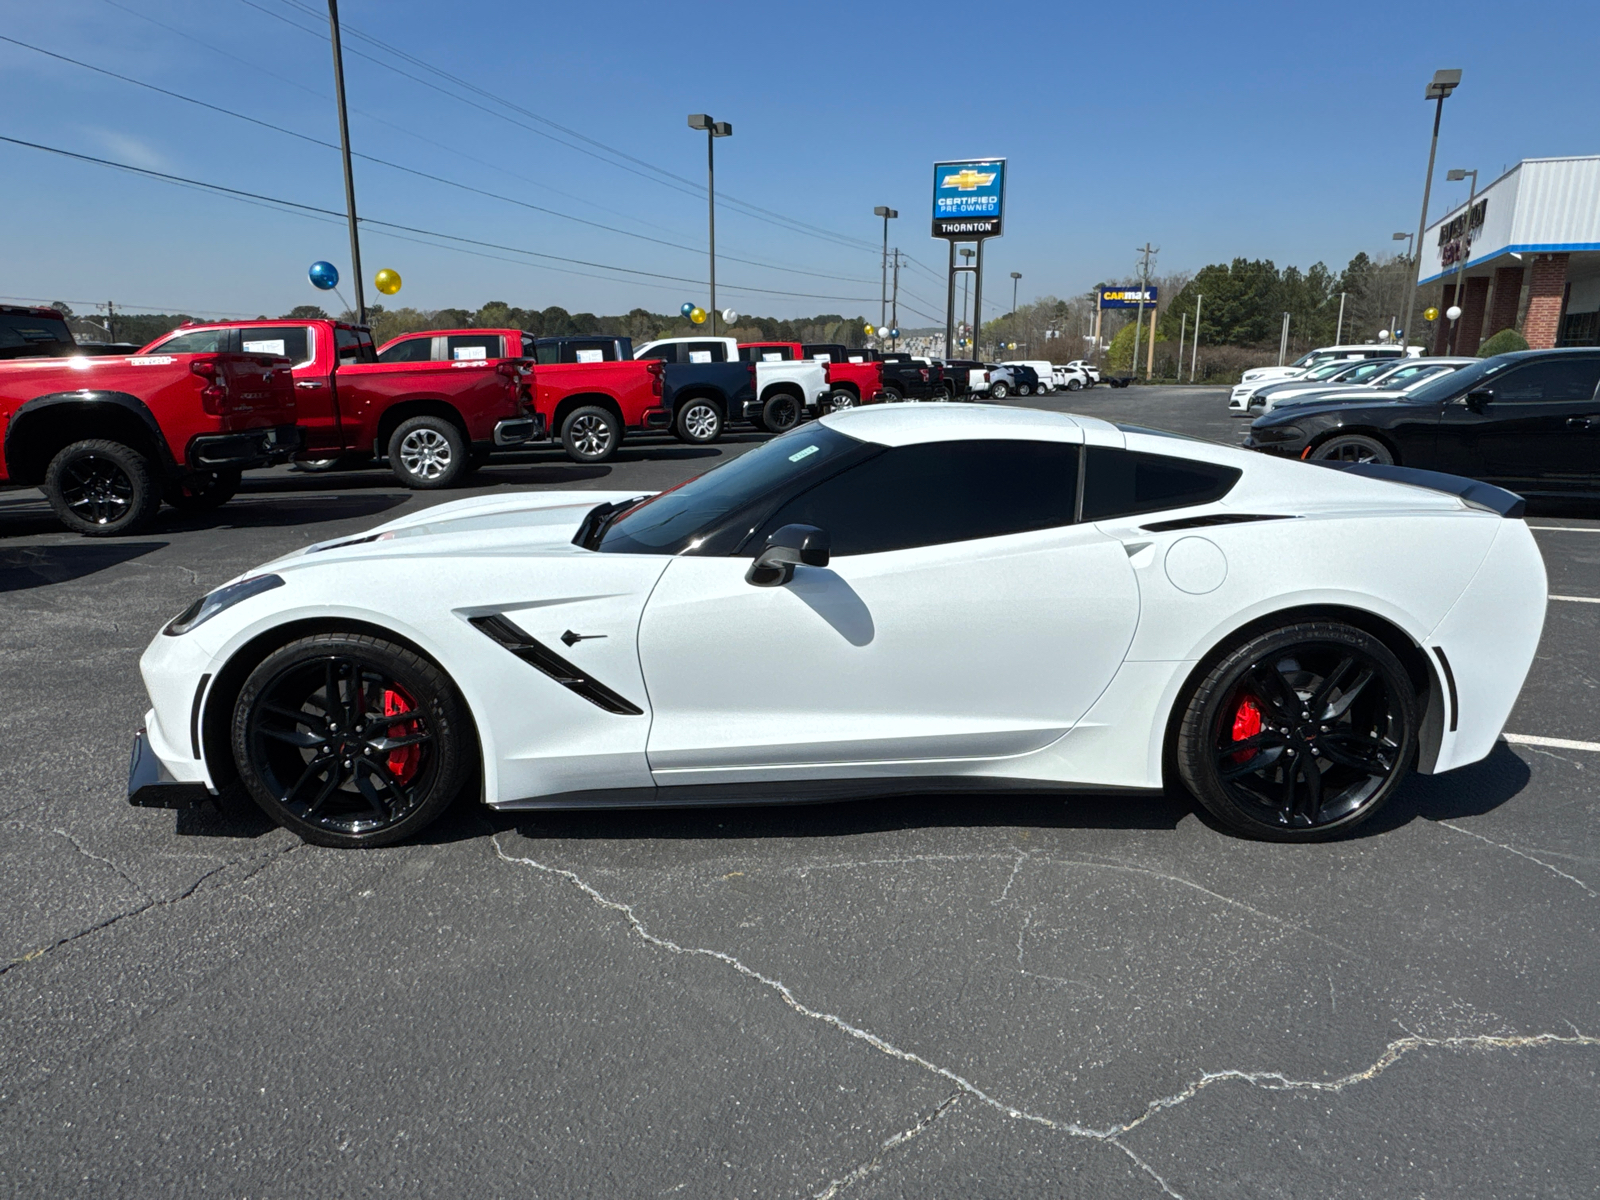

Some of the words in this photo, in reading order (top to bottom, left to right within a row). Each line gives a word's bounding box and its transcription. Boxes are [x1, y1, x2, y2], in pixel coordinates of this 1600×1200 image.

[938, 196, 997, 206] CERTIFIED
[940, 203, 994, 212] PRE-OWNED
[942, 223, 992, 232] THORNTON
